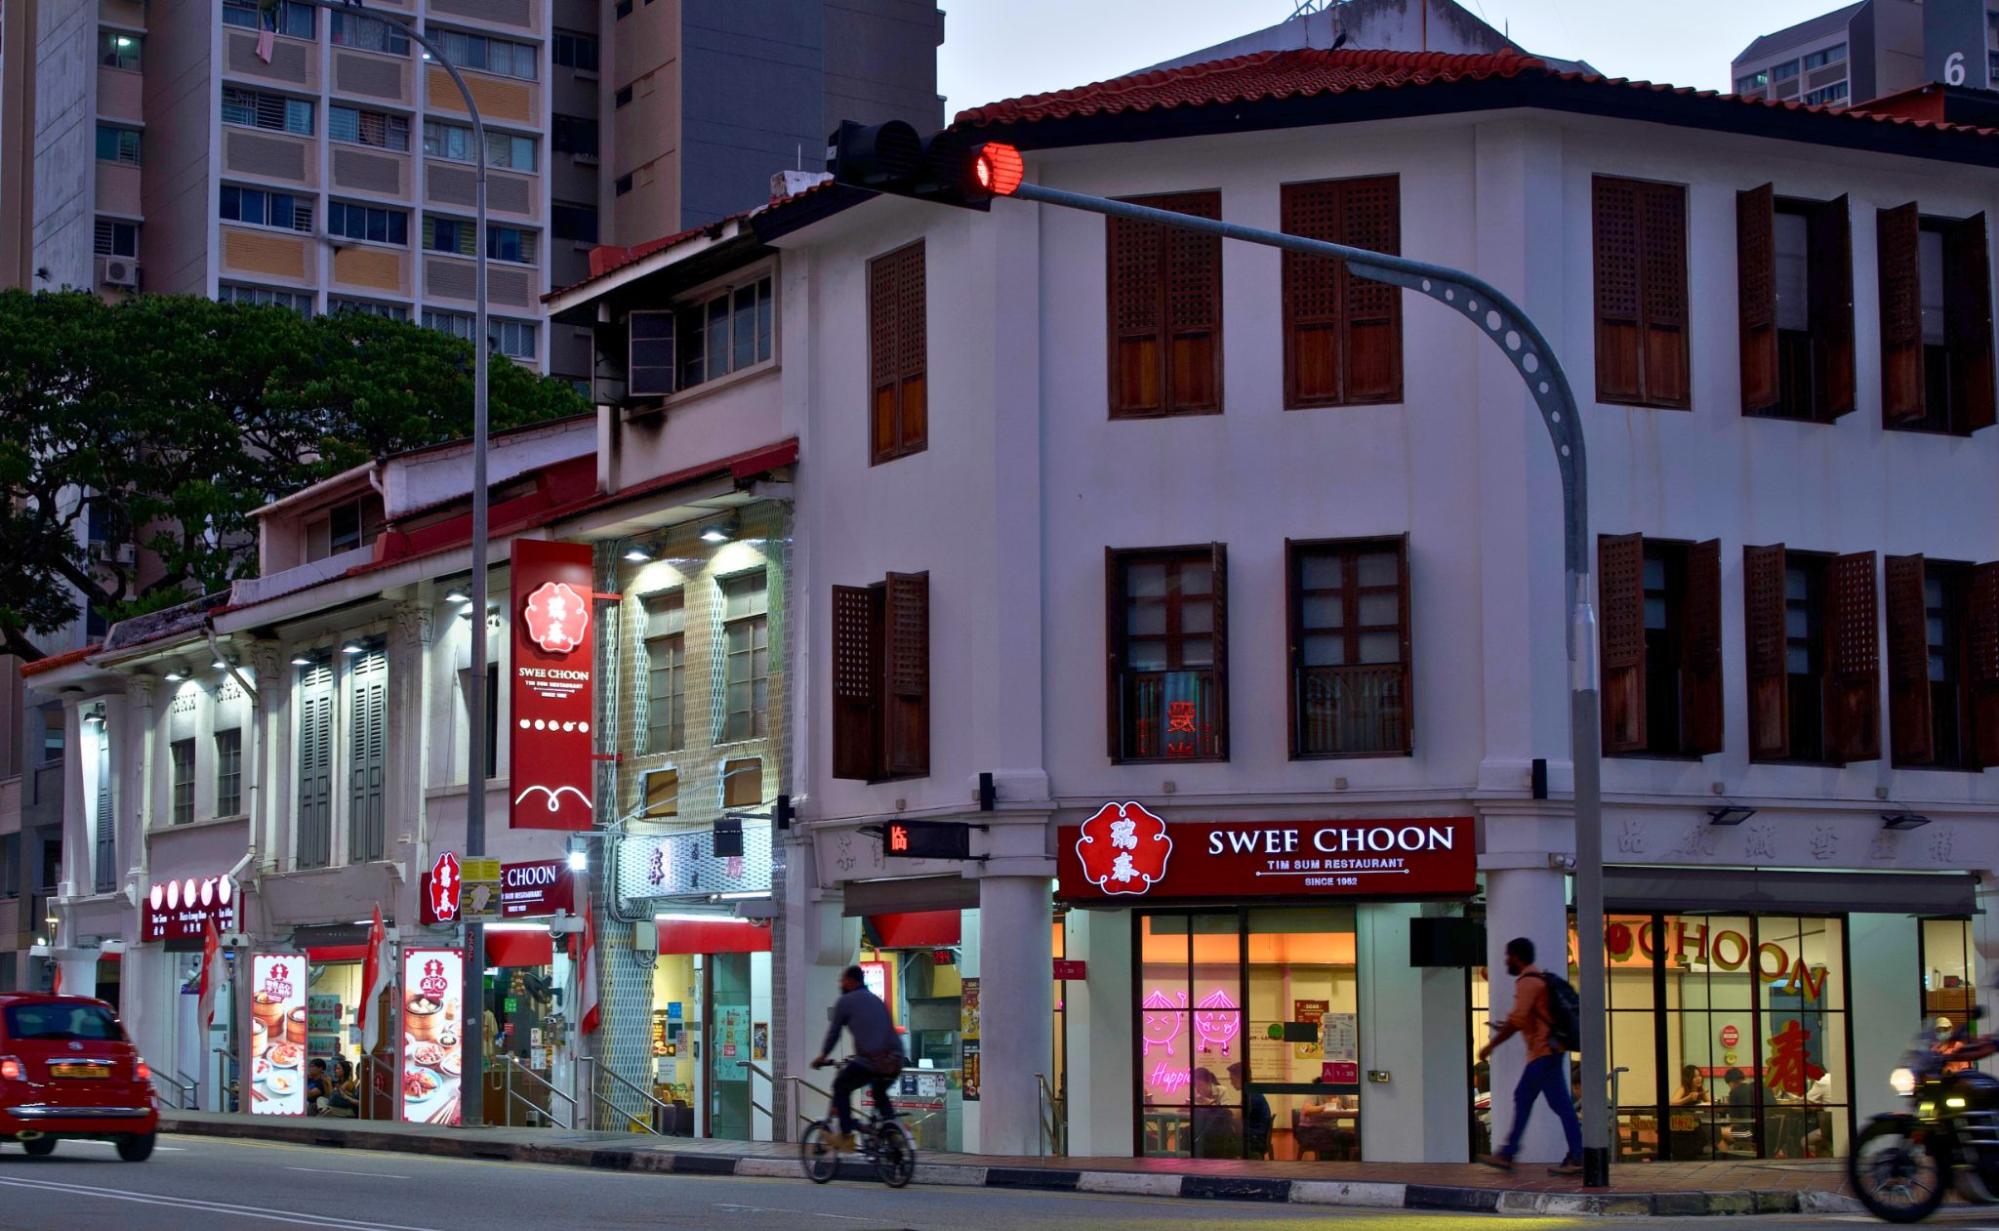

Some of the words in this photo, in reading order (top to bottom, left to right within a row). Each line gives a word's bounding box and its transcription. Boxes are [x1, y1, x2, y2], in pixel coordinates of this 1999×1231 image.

[1944, 51, 1966, 86] 6
[519, 667, 546, 678] SWEE
[547, 668, 590, 681] CHOON
[1109, 817, 1141, 884] 瑞春
[1208, 829, 1299, 855] SWEE
[1313, 826, 1454, 853] CHOON
[507, 865, 556, 887] CHOON
[1267, 860, 1290, 870] TIM
[1294, 859, 1320, 869] SUM
[1325, 858, 1405, 869] RESTAURANT
[1305, 877, 1333, 886] SINCE
[1637, 920, 1829, 1003] CHOON
